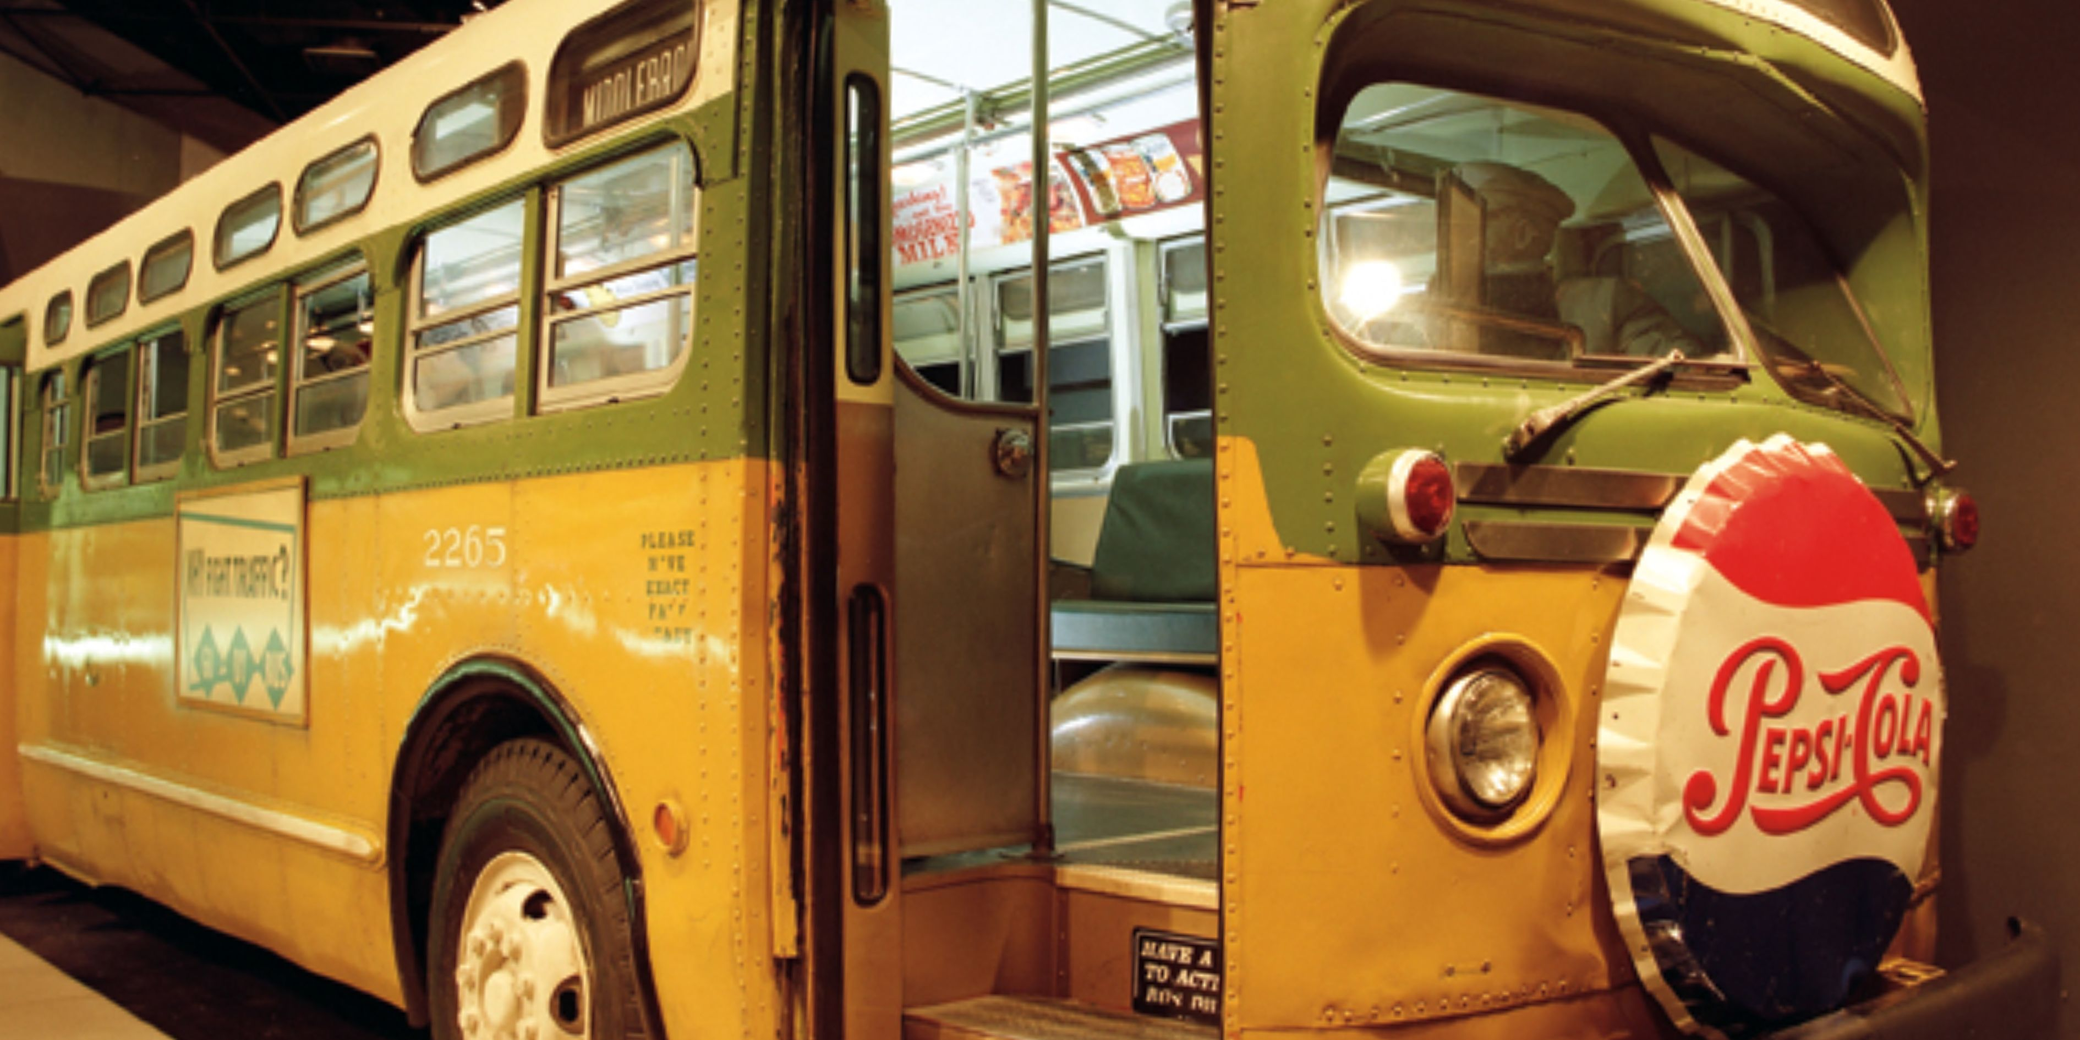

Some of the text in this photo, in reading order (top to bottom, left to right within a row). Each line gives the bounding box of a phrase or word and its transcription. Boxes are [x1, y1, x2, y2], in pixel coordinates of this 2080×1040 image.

[423, 525, 507, 568] 2265
[641, 530, 695, 550] PLEASE
[648, 555, 686, 573] HVE
[1682, 635, 1933, 837] PEPSI-COLA
[1200, 950, 1213, 968] A
[1144, 963, 1170, 983] TO
